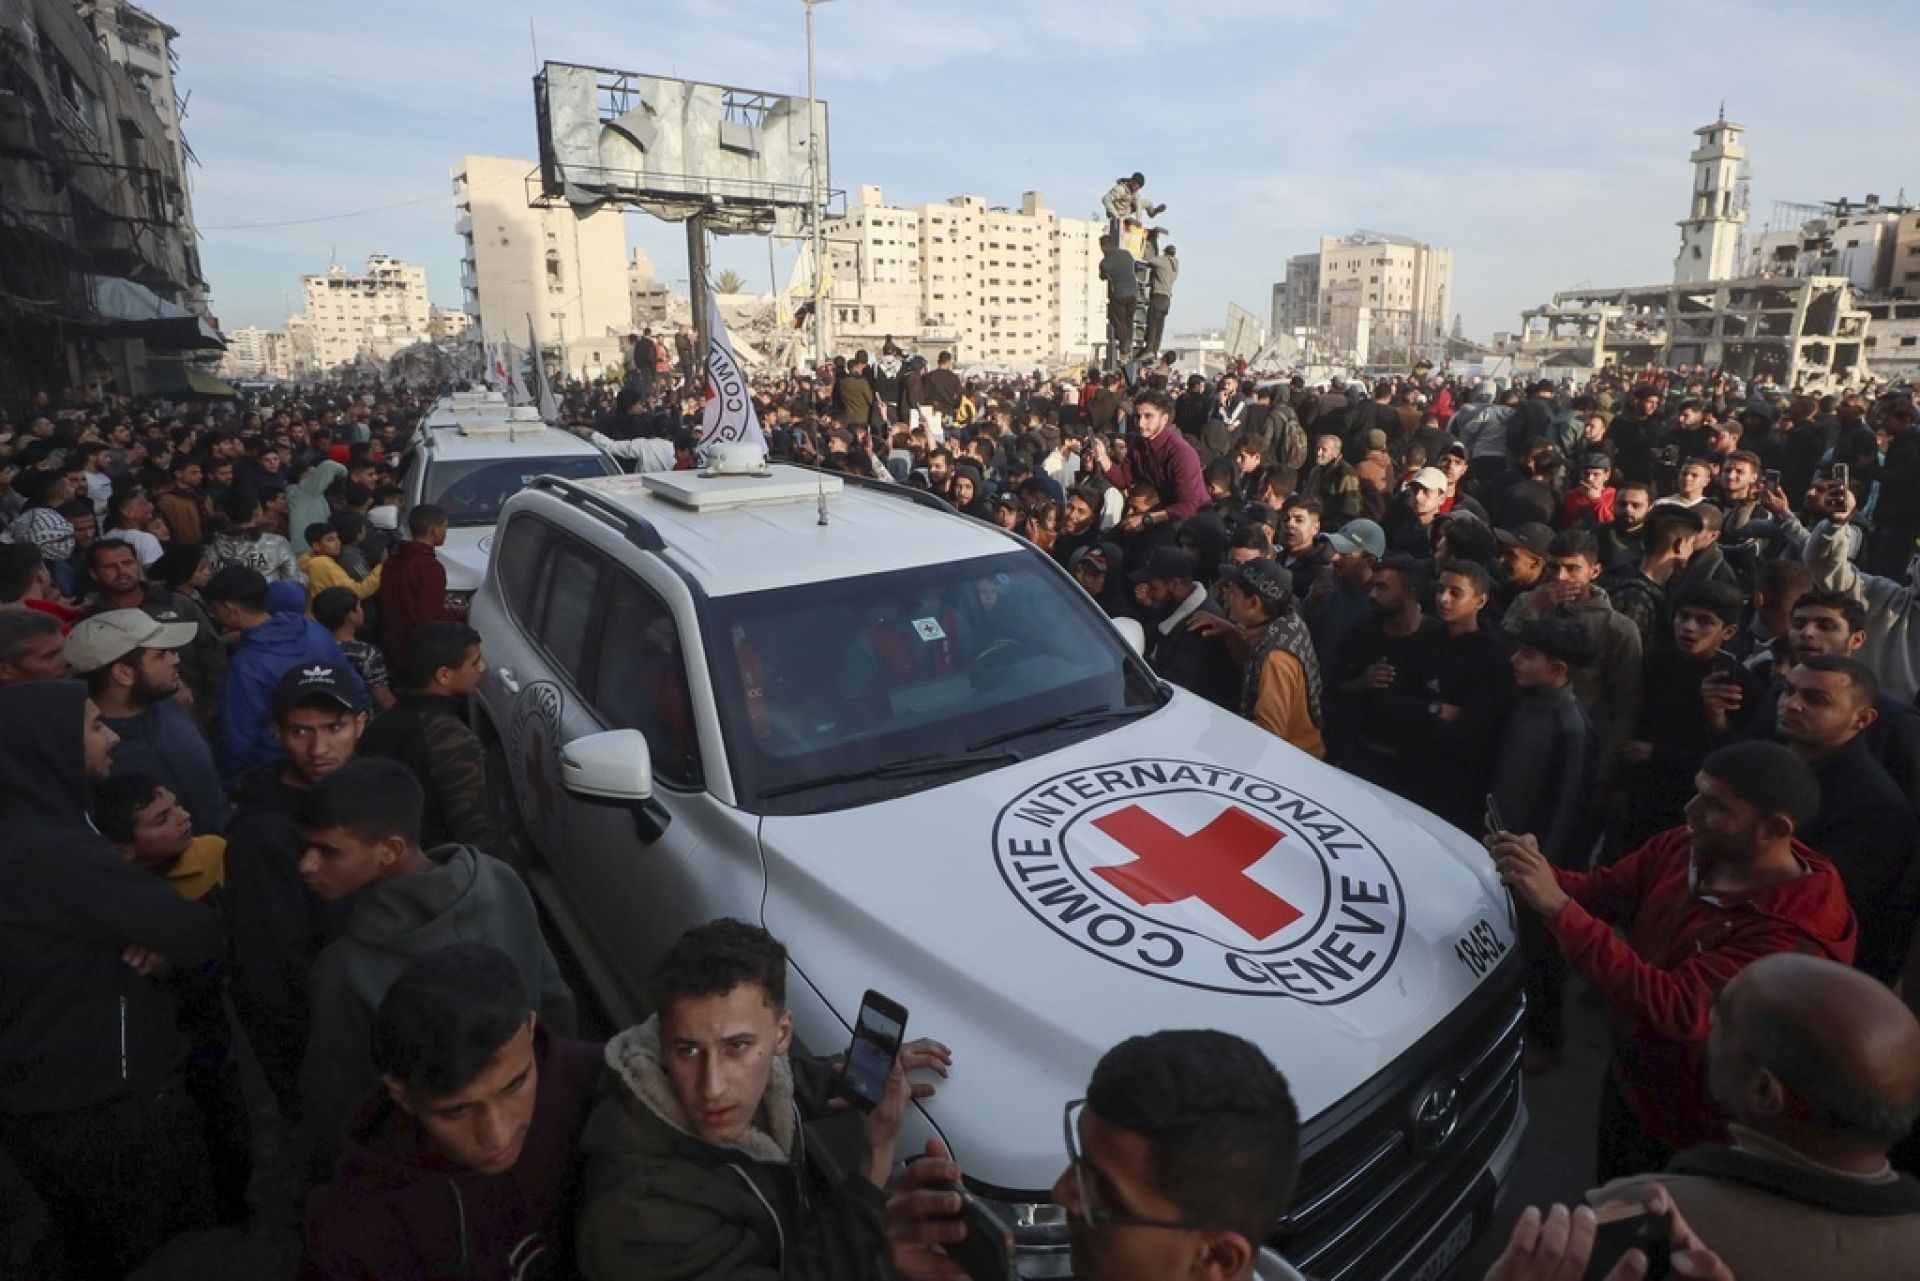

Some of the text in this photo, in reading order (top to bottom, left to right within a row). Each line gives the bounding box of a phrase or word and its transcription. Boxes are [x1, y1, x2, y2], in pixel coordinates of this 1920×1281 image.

[1009, 763, 1389, 995] COMITE INTERNATIONAL GENEVE
[1454, 919, 1507, 978] 18452
